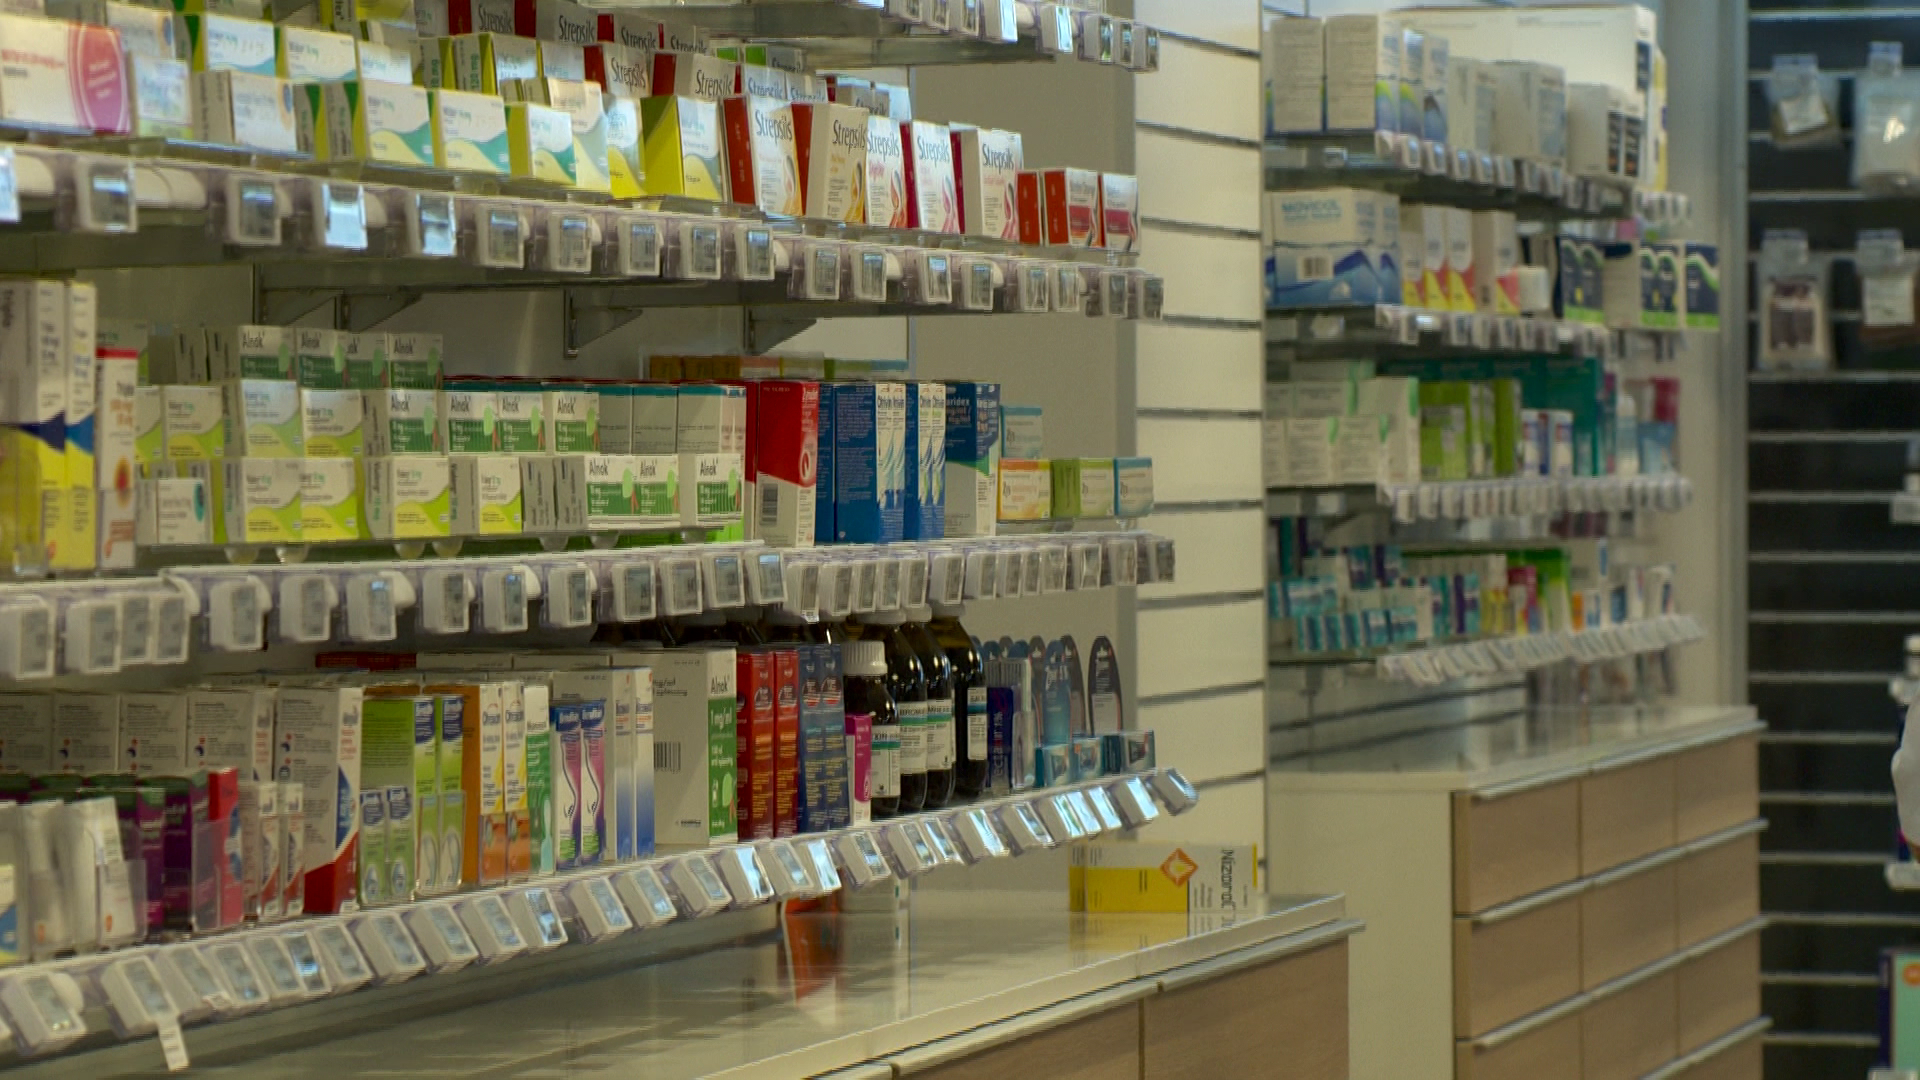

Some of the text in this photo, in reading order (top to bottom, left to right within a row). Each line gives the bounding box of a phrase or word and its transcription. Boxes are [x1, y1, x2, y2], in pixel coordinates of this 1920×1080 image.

[558, 15, 595, 46] Strepsils
[611, 56, 647, 92] Strepsils
[756, 109, 793, 144] Strepsils
[832, 119, 868, 154] Strepsils
[918, 135, 950, 167] Strepsils
[982, 142, 1015, 176] Strepsils
